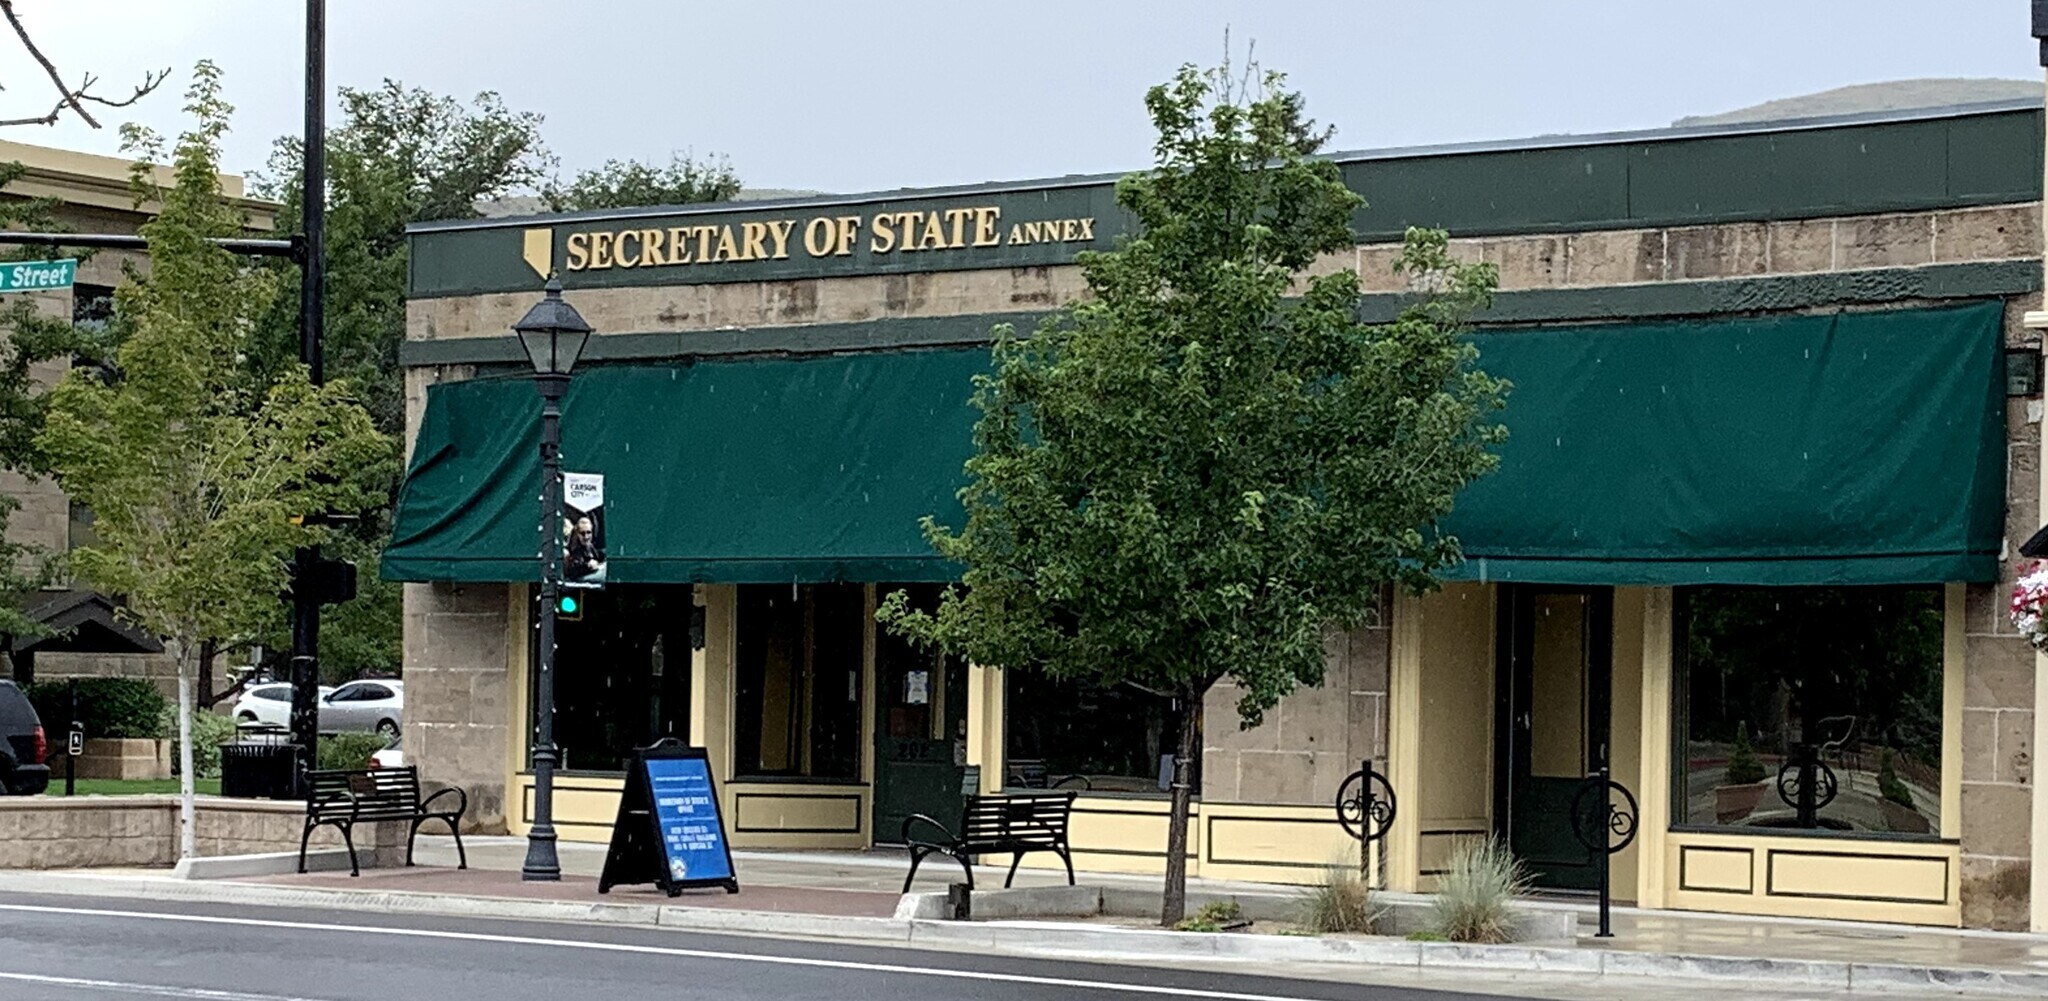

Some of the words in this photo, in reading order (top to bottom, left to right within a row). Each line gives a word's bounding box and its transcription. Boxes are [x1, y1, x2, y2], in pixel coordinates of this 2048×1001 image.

[567, 220, 796, 271] SECRETARY
[804, 215, 861, 258] OF
[871, 206, 1000, 253] STATE
[1007, 217, 1095, 246] ANNEX
[10, 264, 68, 287] Street
